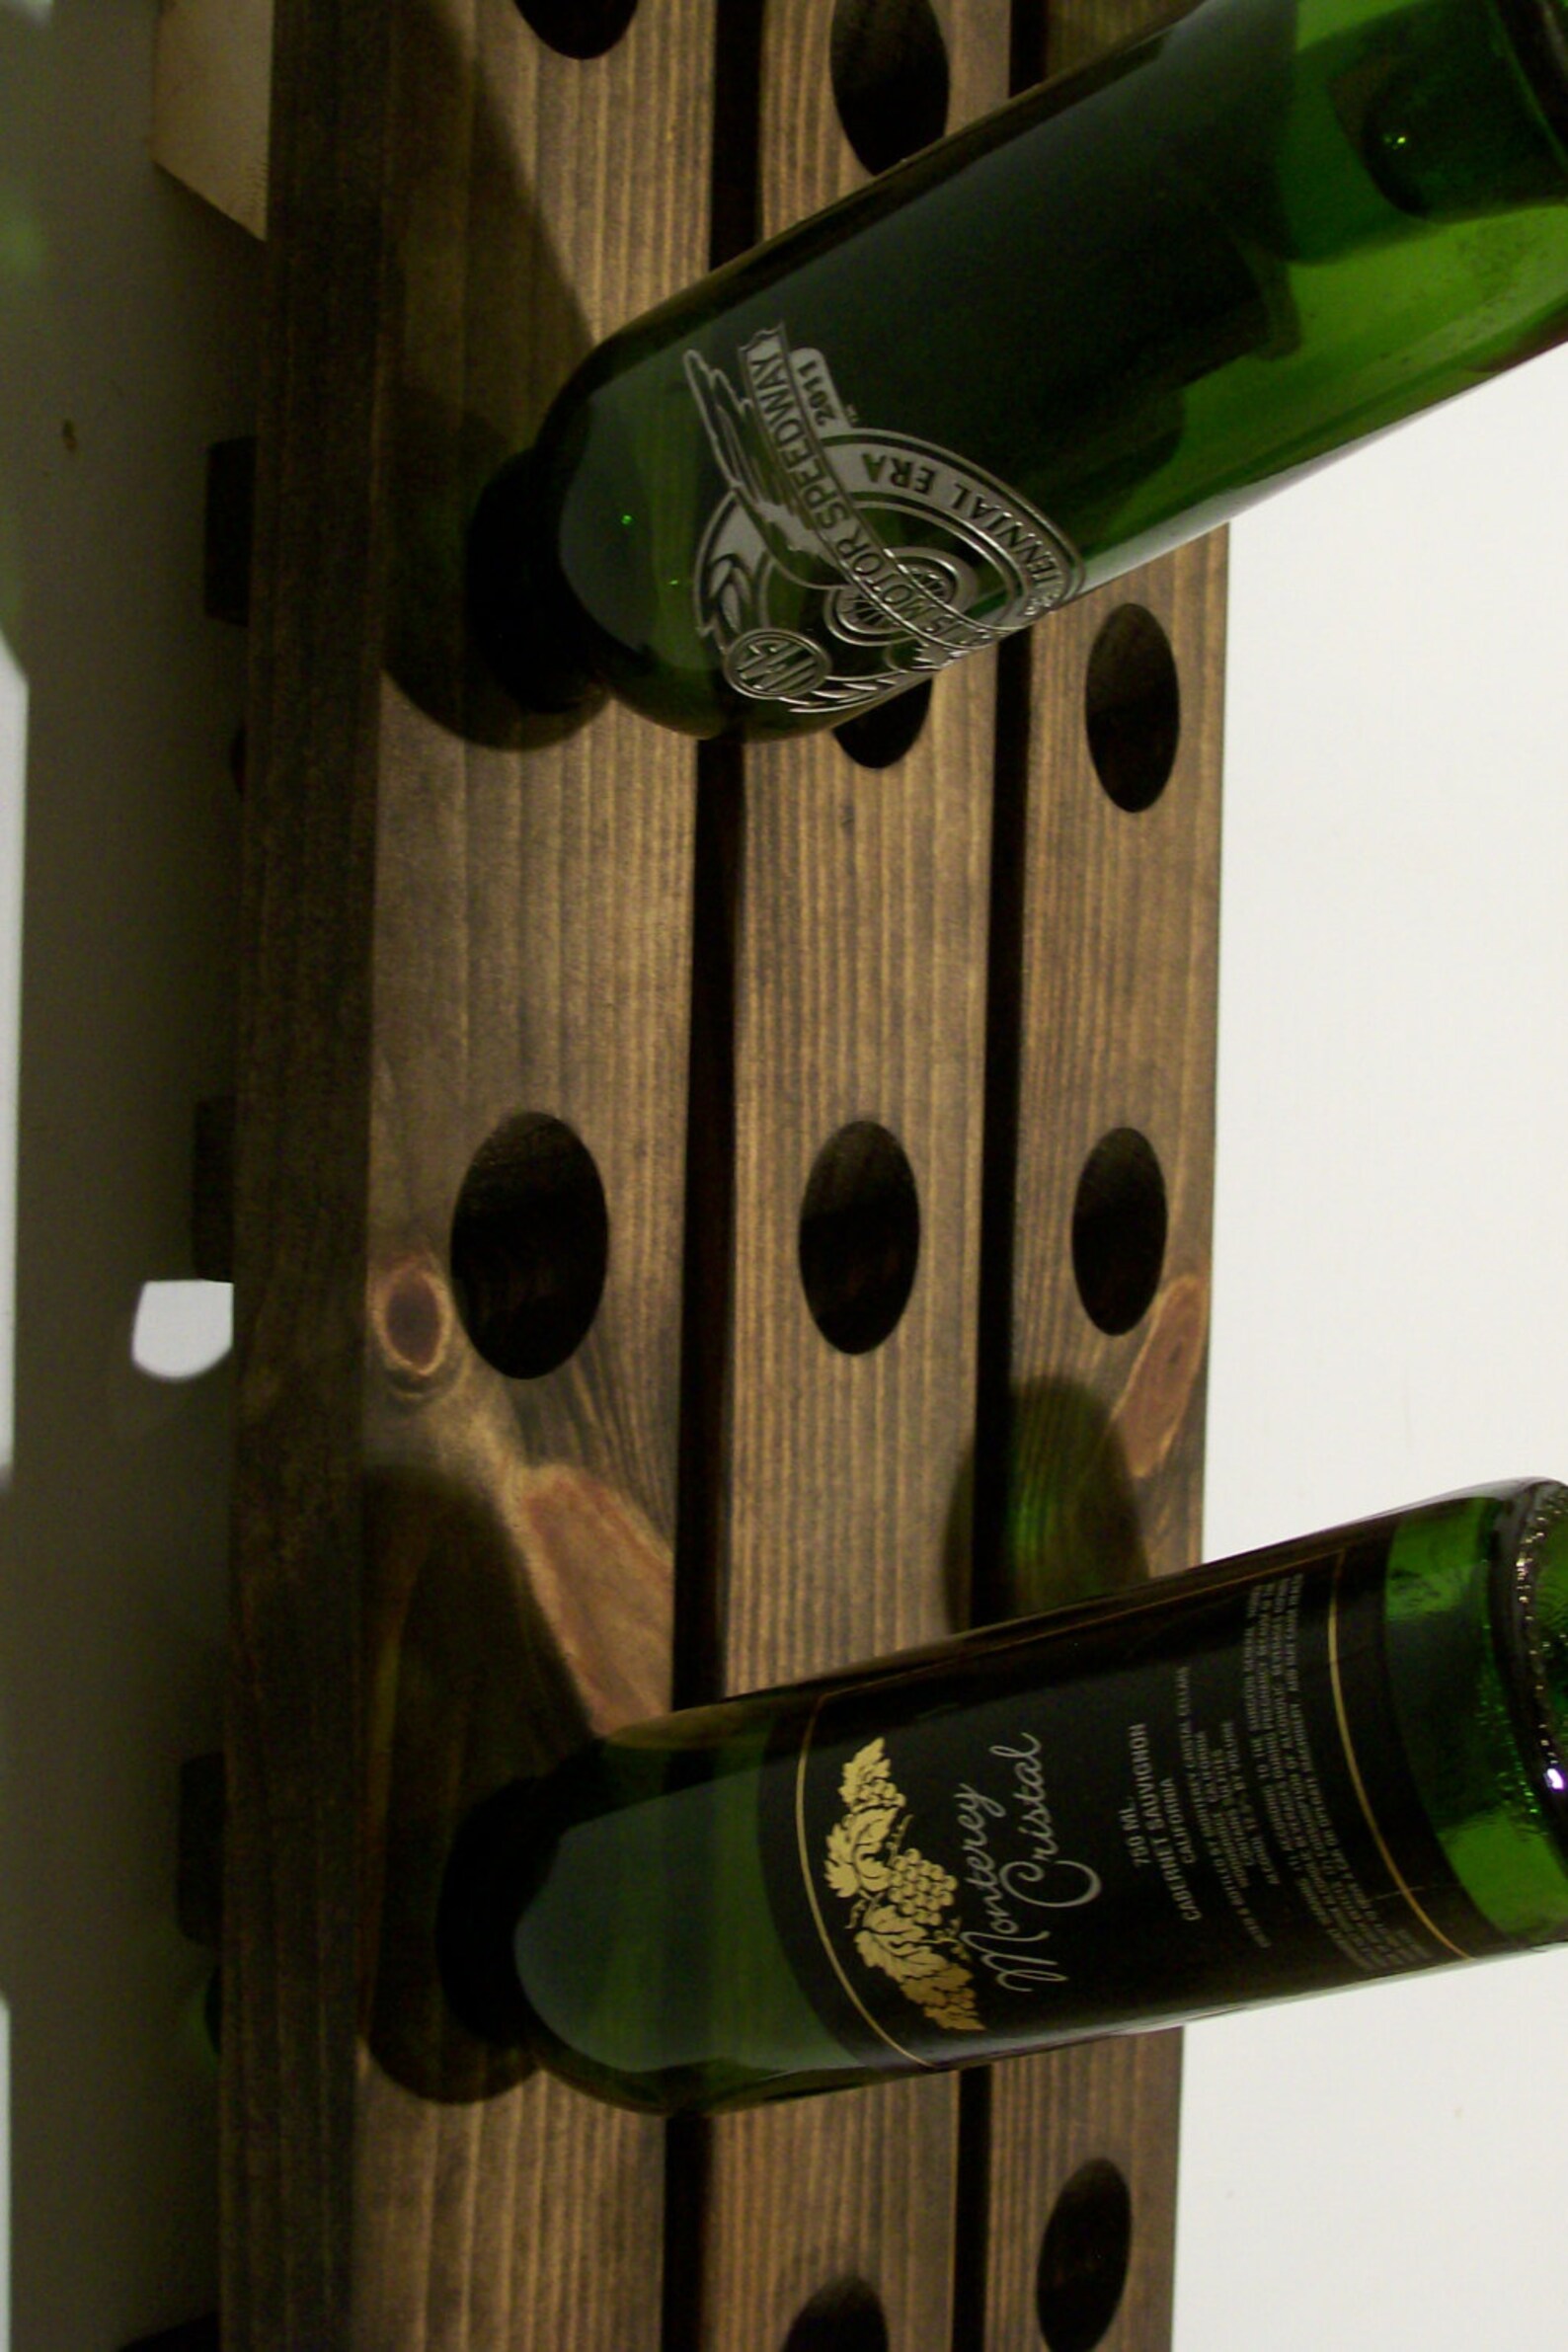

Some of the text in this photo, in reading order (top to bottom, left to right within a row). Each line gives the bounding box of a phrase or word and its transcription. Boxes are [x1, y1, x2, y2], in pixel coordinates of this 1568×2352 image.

[797, 360, 836, 426] 2011
[749, 350, 933, 625] MOTOR SPEEDWAY
[860, 452, 936, 495] ERA
[989, 1732, 1101, 1908] Cristal
[1126, 1835, 1150, 1866] 750
[1130, 1723, 1202, 1921] CABERNET SAUVIGNON
[1160, 1778, 1197, 1863] CALIFORNIA
[954, 1783, 1067, 1993] Monterey
